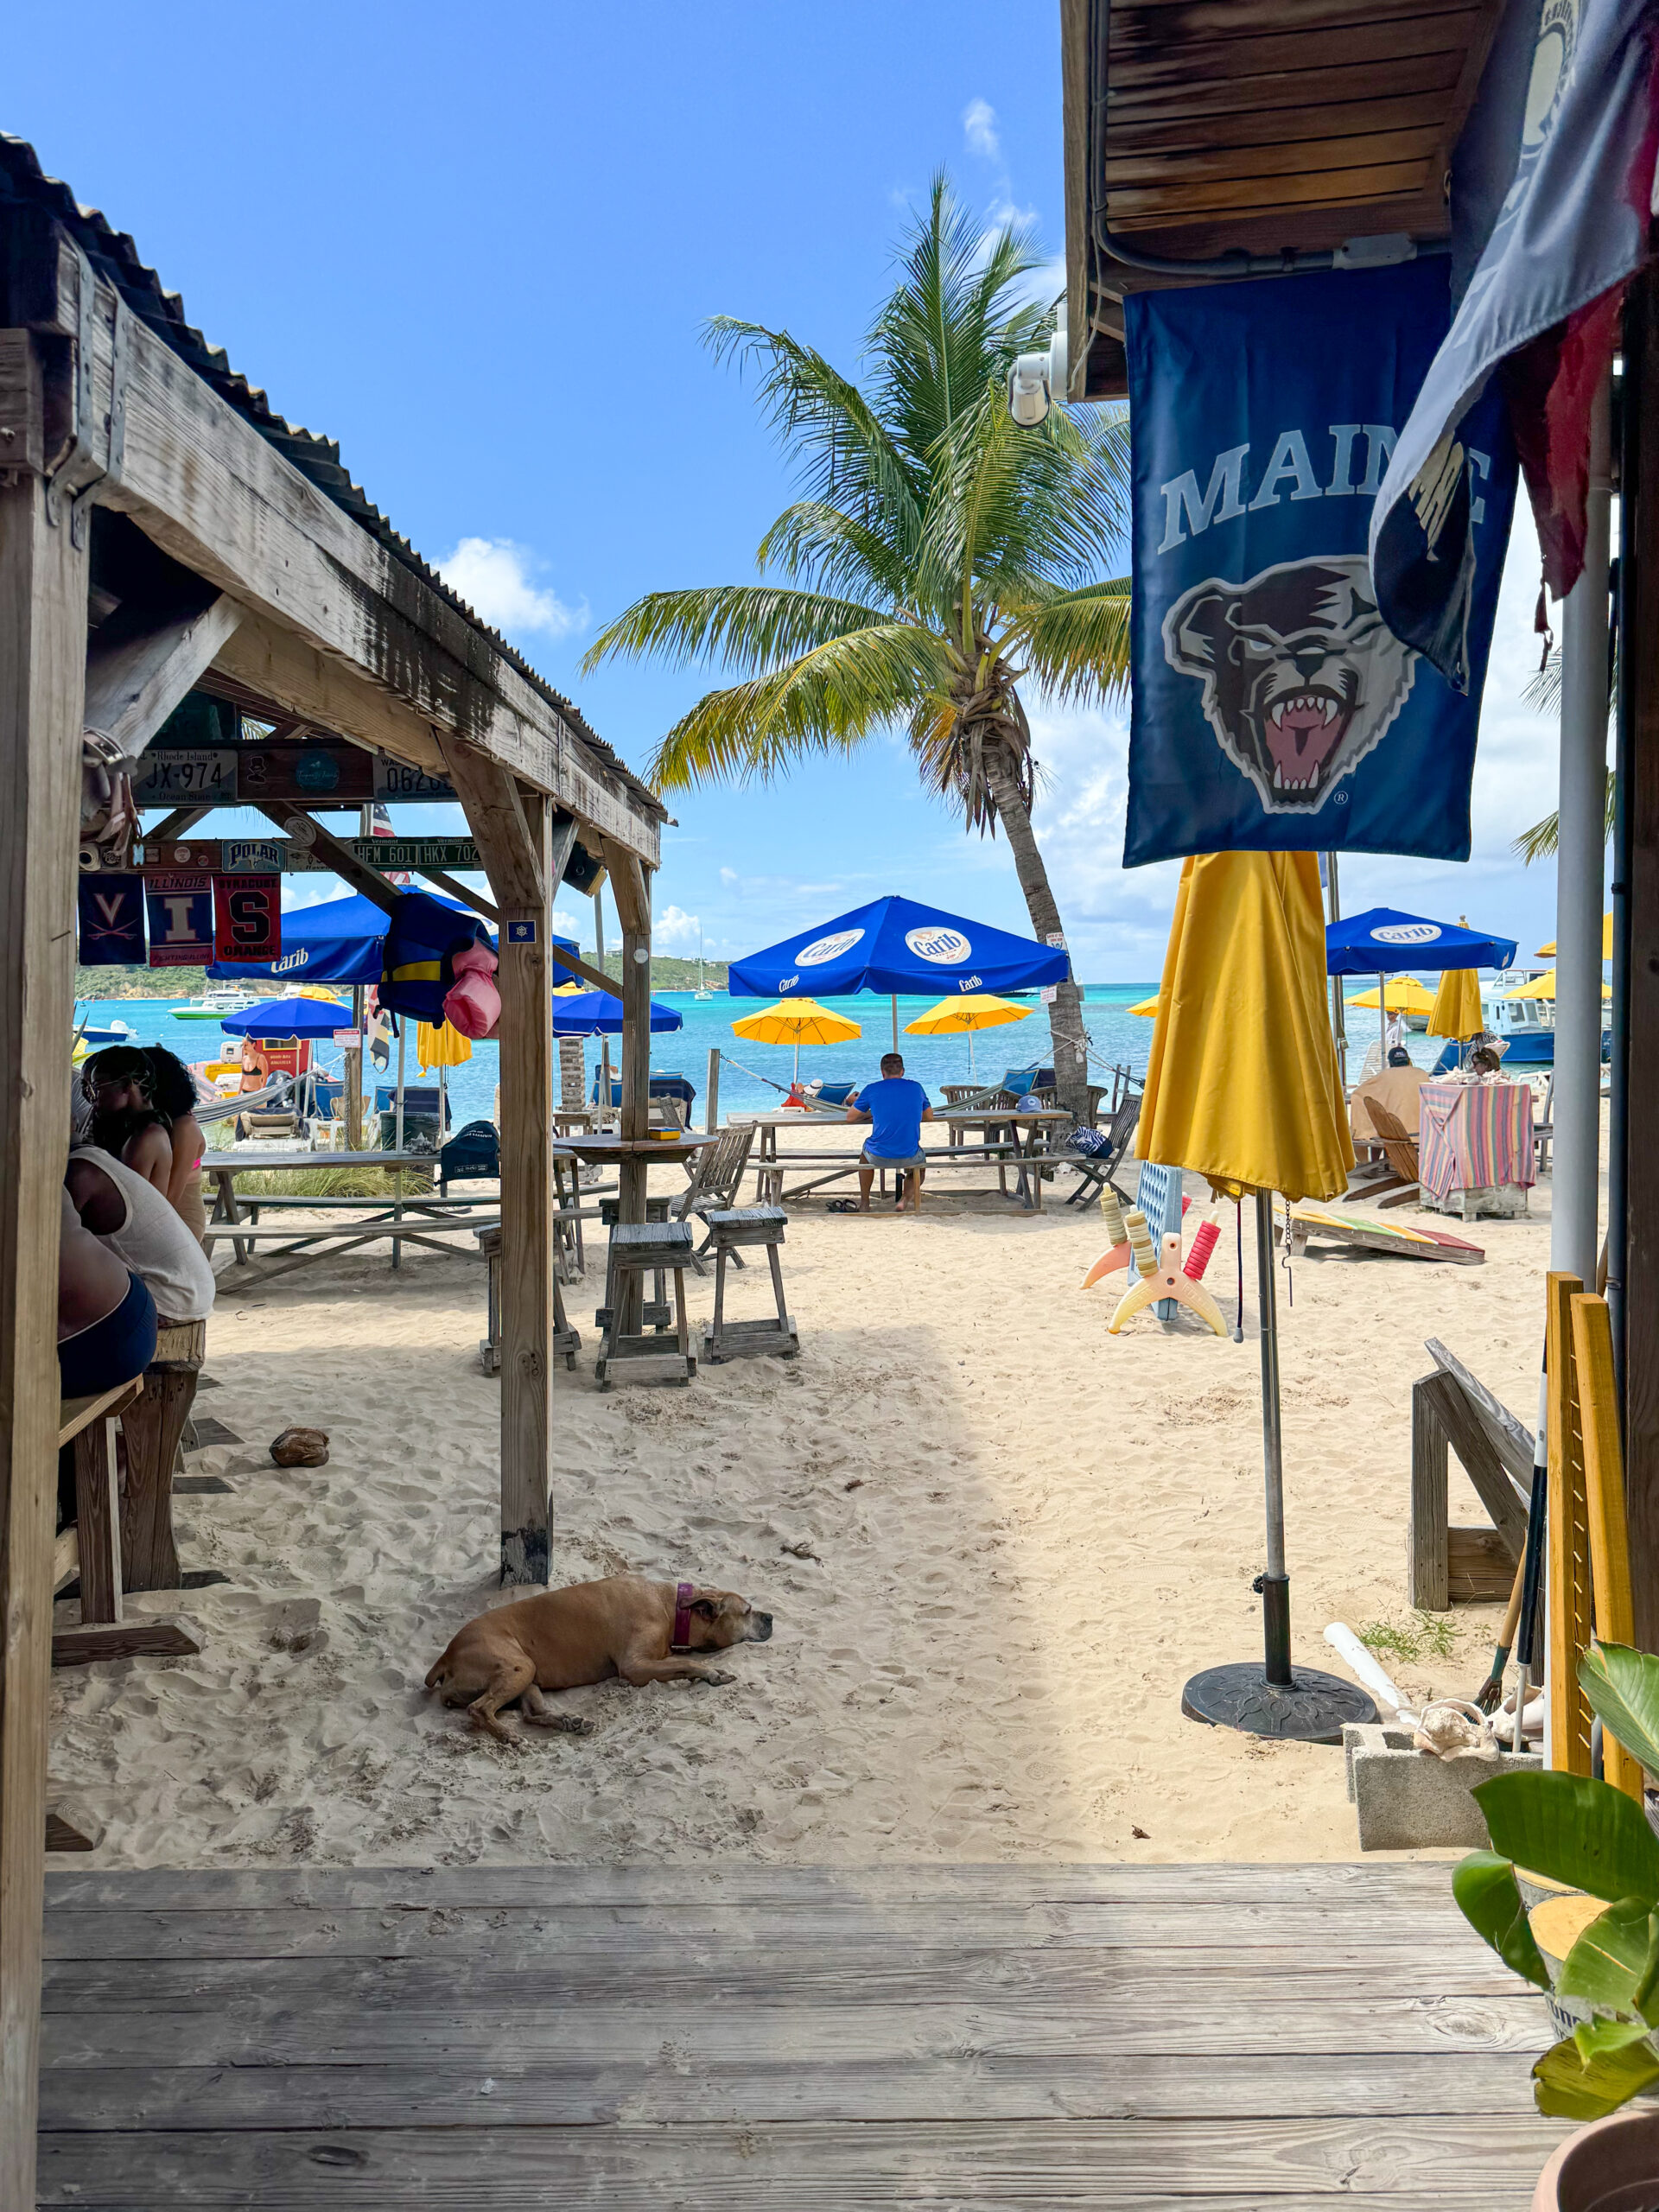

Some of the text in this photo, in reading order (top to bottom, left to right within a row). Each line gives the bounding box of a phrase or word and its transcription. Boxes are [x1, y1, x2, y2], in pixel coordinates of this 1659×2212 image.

[157, 751, 213, 761] Rhode Island
[228, 842, 279, 868] POLAR
[358, 846, 412, 862] HFM 601
[423, 845, 479, 862] HKX 702
[149, 877, 206, 888] ILLINOIS
[93, 893, 126, 928] V
[162, 896, 198, 942] I
[228, 890, 271, 944] S
[1378, 927, 1433, 941] Carib
[224, 945, 276, 957] ORANGE
[803, 935, 859, 958] Carib
[913, 933, 961, 957] Carib
[779, 974, 799, 993] Carib
[958, 975, 982, 993] Carib
